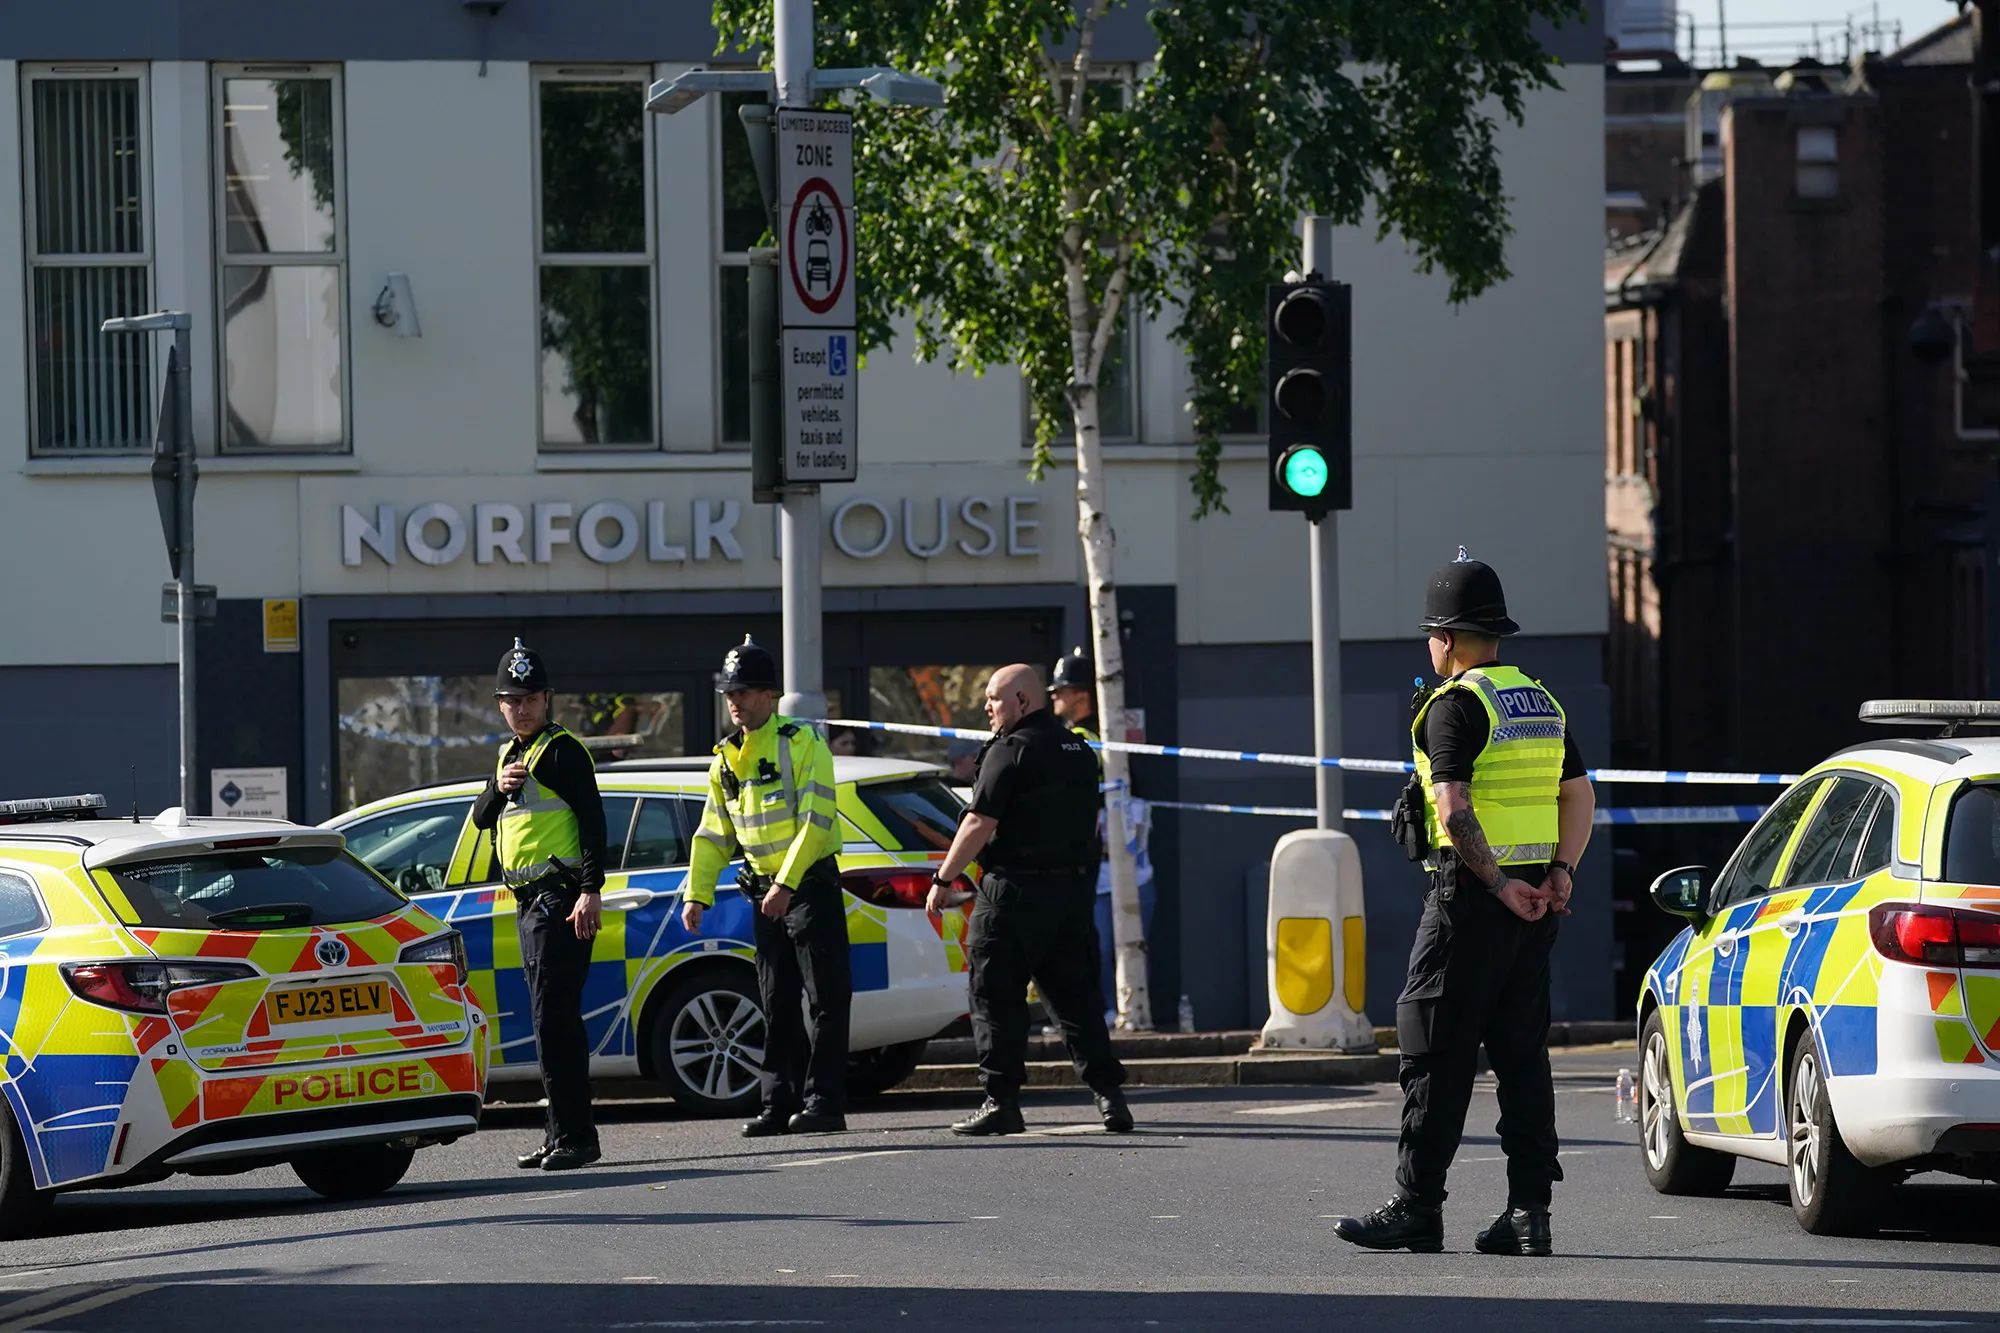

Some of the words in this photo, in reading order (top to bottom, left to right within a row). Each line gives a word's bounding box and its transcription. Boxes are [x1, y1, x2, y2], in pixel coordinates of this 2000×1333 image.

[781, 117, 815, 132] LIMITED
[817, 119, 850, 134] ACCESS
[796, 144, 833, 167] ZONE
[793, 346, 827, 367] Except
[797, 383, 844, 402] permitted
[800, 428, 823, 445] taxis
[826, 428, 843, 445] and
[796, 450, 811, 468] for
[813, 451, 847, 471] loading
[341, 499, 744, 566] NORFOLK
[773, 496, 1040, 561] OUSE
[1500, 691, 1556, 714] POLICE
[276, 990, 335, 1018] FJ23
[339, 985, 380, 1012] ELV
[200, 1045, 248, 1056] COROLLA
[274, 1065, 421, 1105] POLICE
